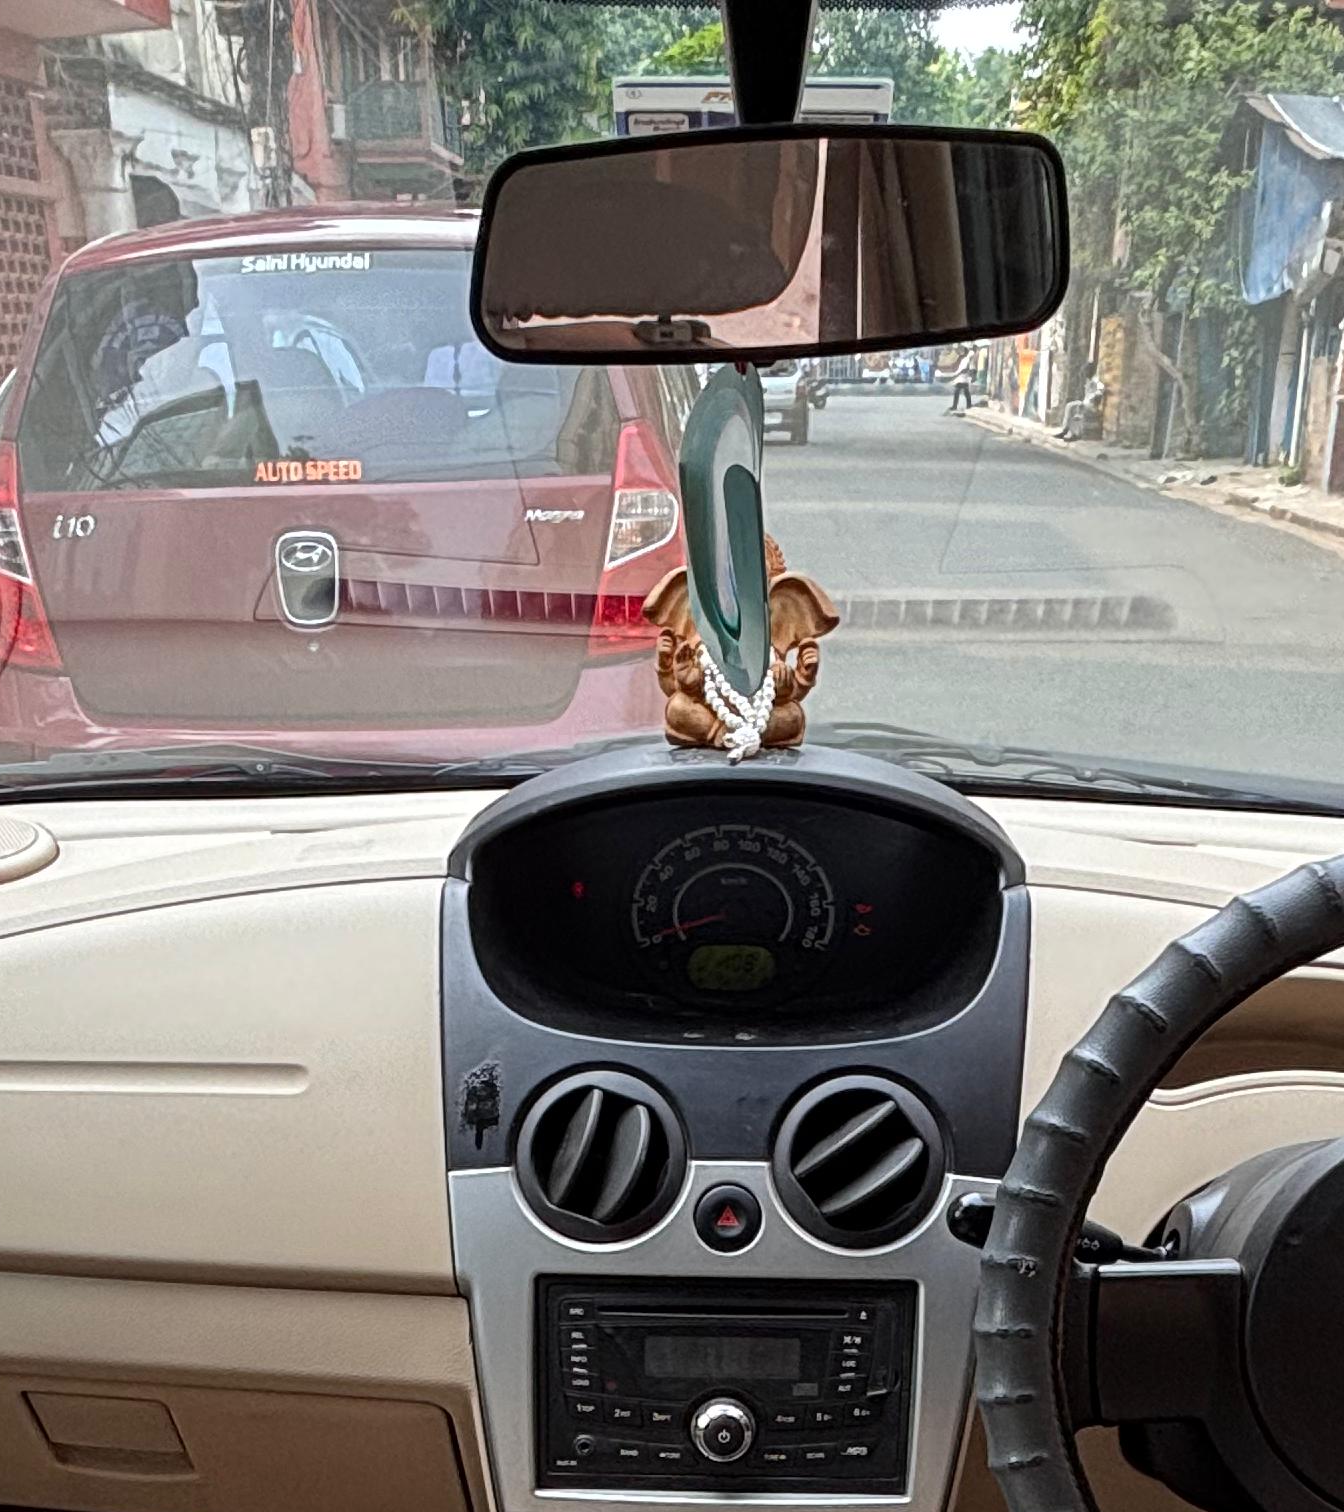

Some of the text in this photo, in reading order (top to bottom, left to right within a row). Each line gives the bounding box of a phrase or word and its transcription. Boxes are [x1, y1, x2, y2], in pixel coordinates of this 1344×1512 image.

[290, 252, 370, 273] Hyundai
[255, 460, 362, 483] AUTO SPEED
[52, 514, 96, 539] i10
[737, 840, 761, 853] 100
[659, 865, 674, 882] 40
